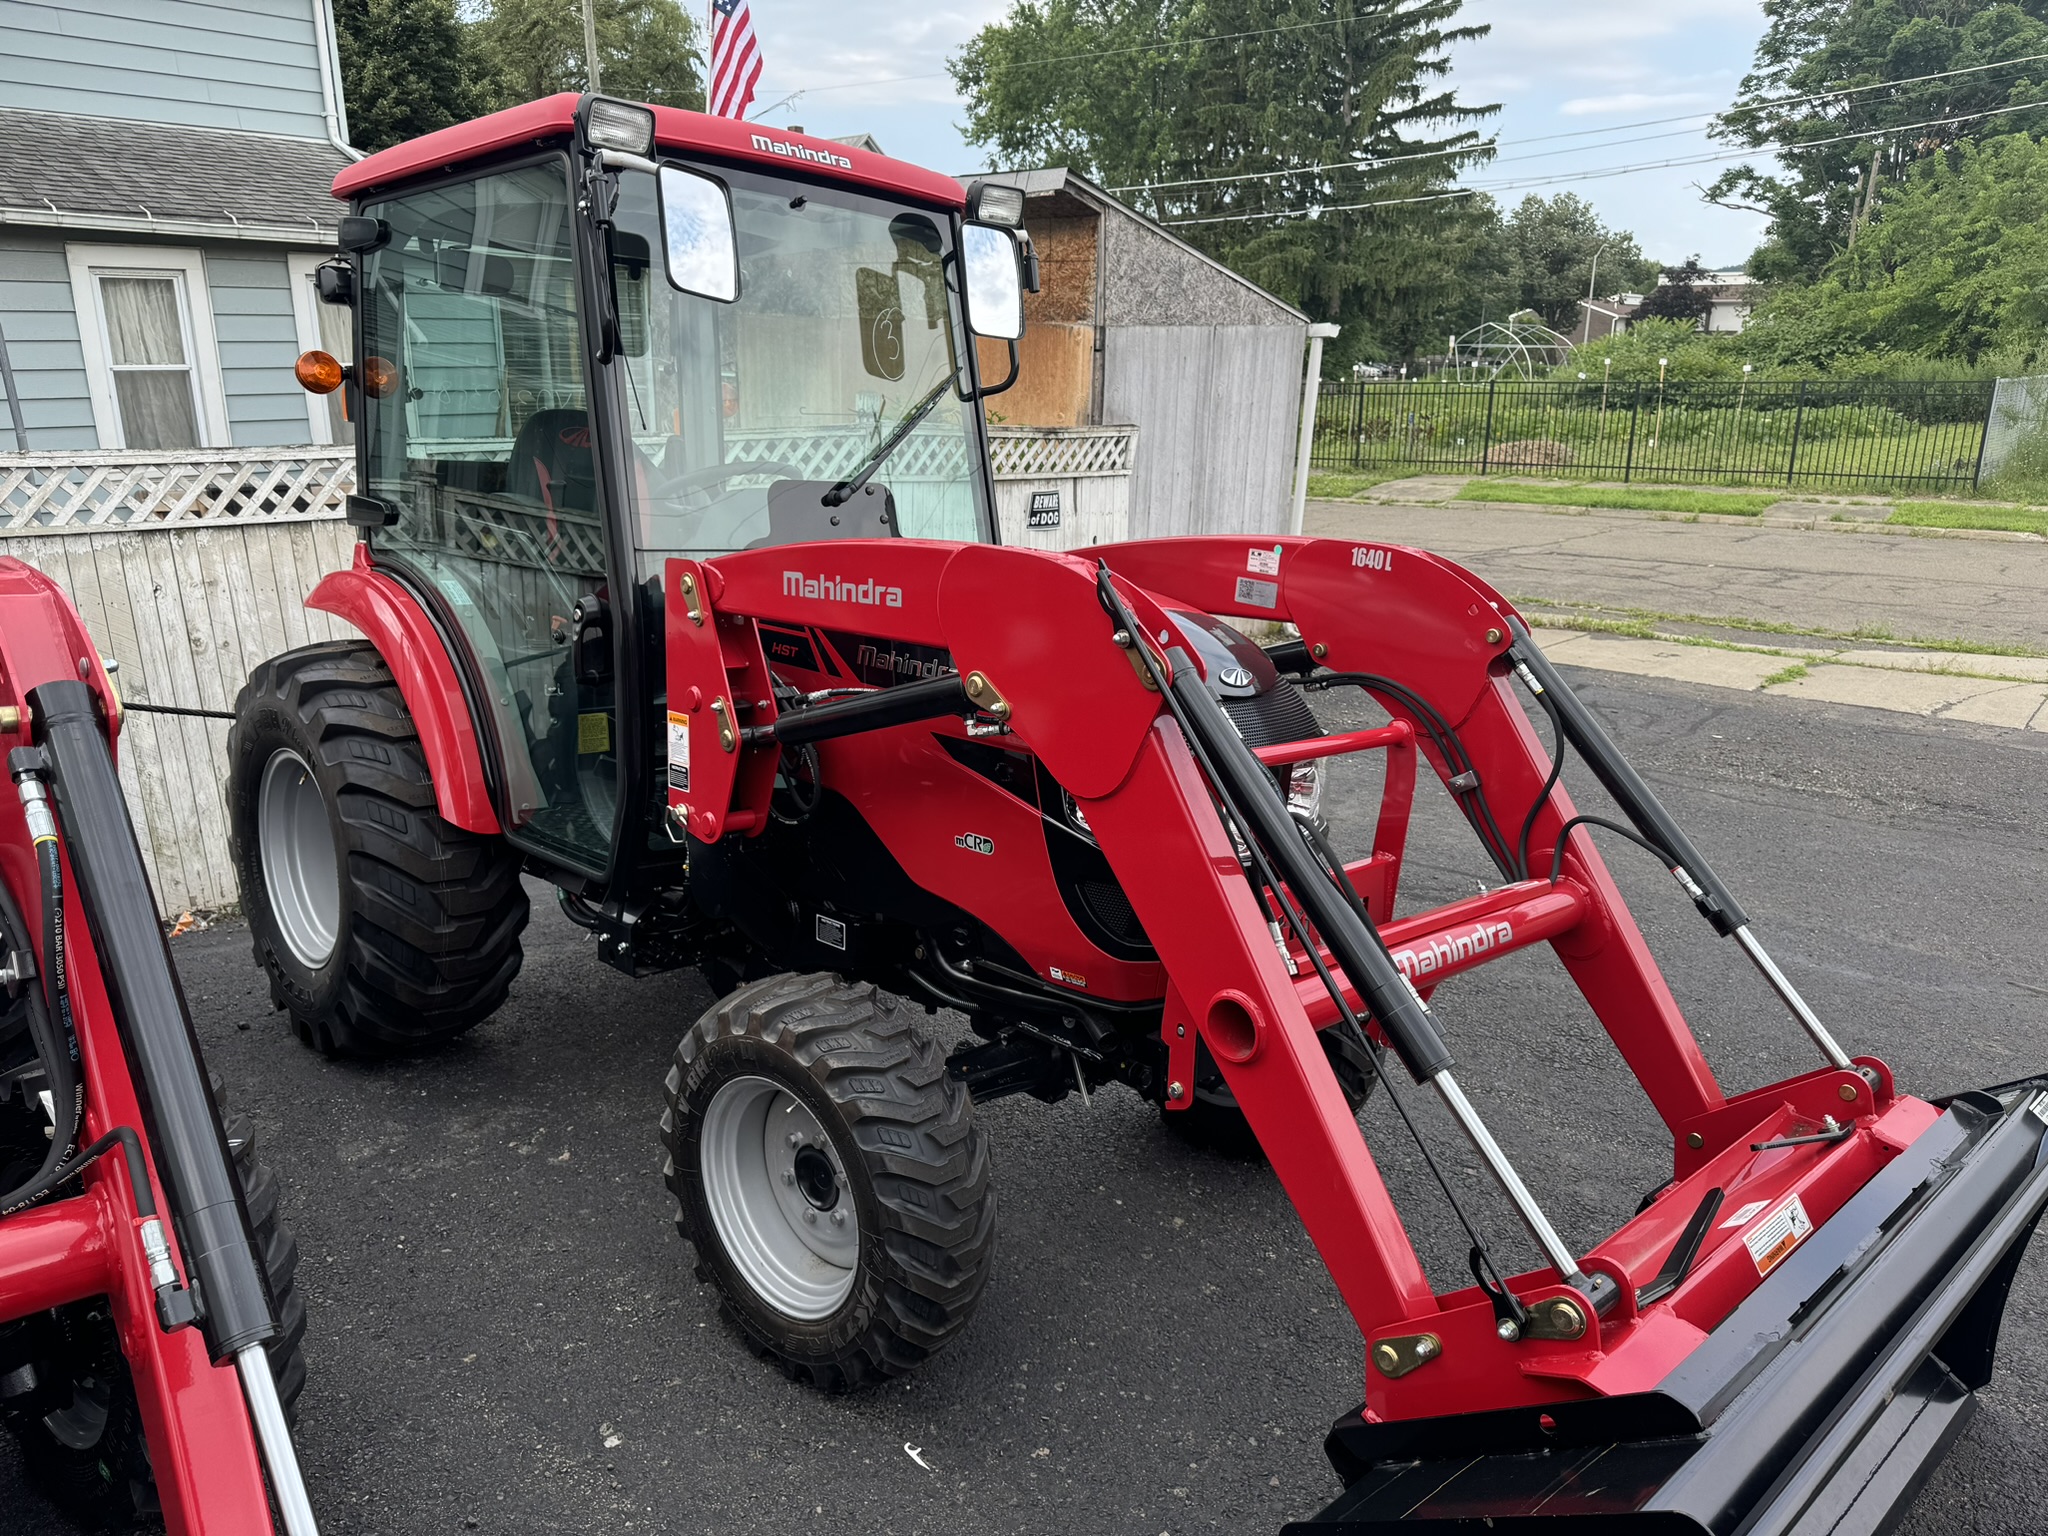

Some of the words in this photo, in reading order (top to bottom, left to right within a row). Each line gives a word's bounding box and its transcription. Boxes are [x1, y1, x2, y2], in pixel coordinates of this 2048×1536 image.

[750, 134, 852, 169] Mahindra
[1033, 494, 1059, 509] BEWARE
[1030, 513, 1041, 525] of
[1040, 511, 1059, 525] DOG
[1351, 547, 1385, 570] 1640
[1384, 551, 1392, 571] L
[783, 571, 902, 608] Mahindra
[772, 642, 799, 657] HST
[857, 644, 957, 679] Mahindr
[54, 917, 62, 933] 210
[55, 935, 63, 951] BAR
[1394, 921, 1513, 980] Mahindra
[56, 952, 65, 975] (3050
[74, 1082, 84, 1115] Winner
